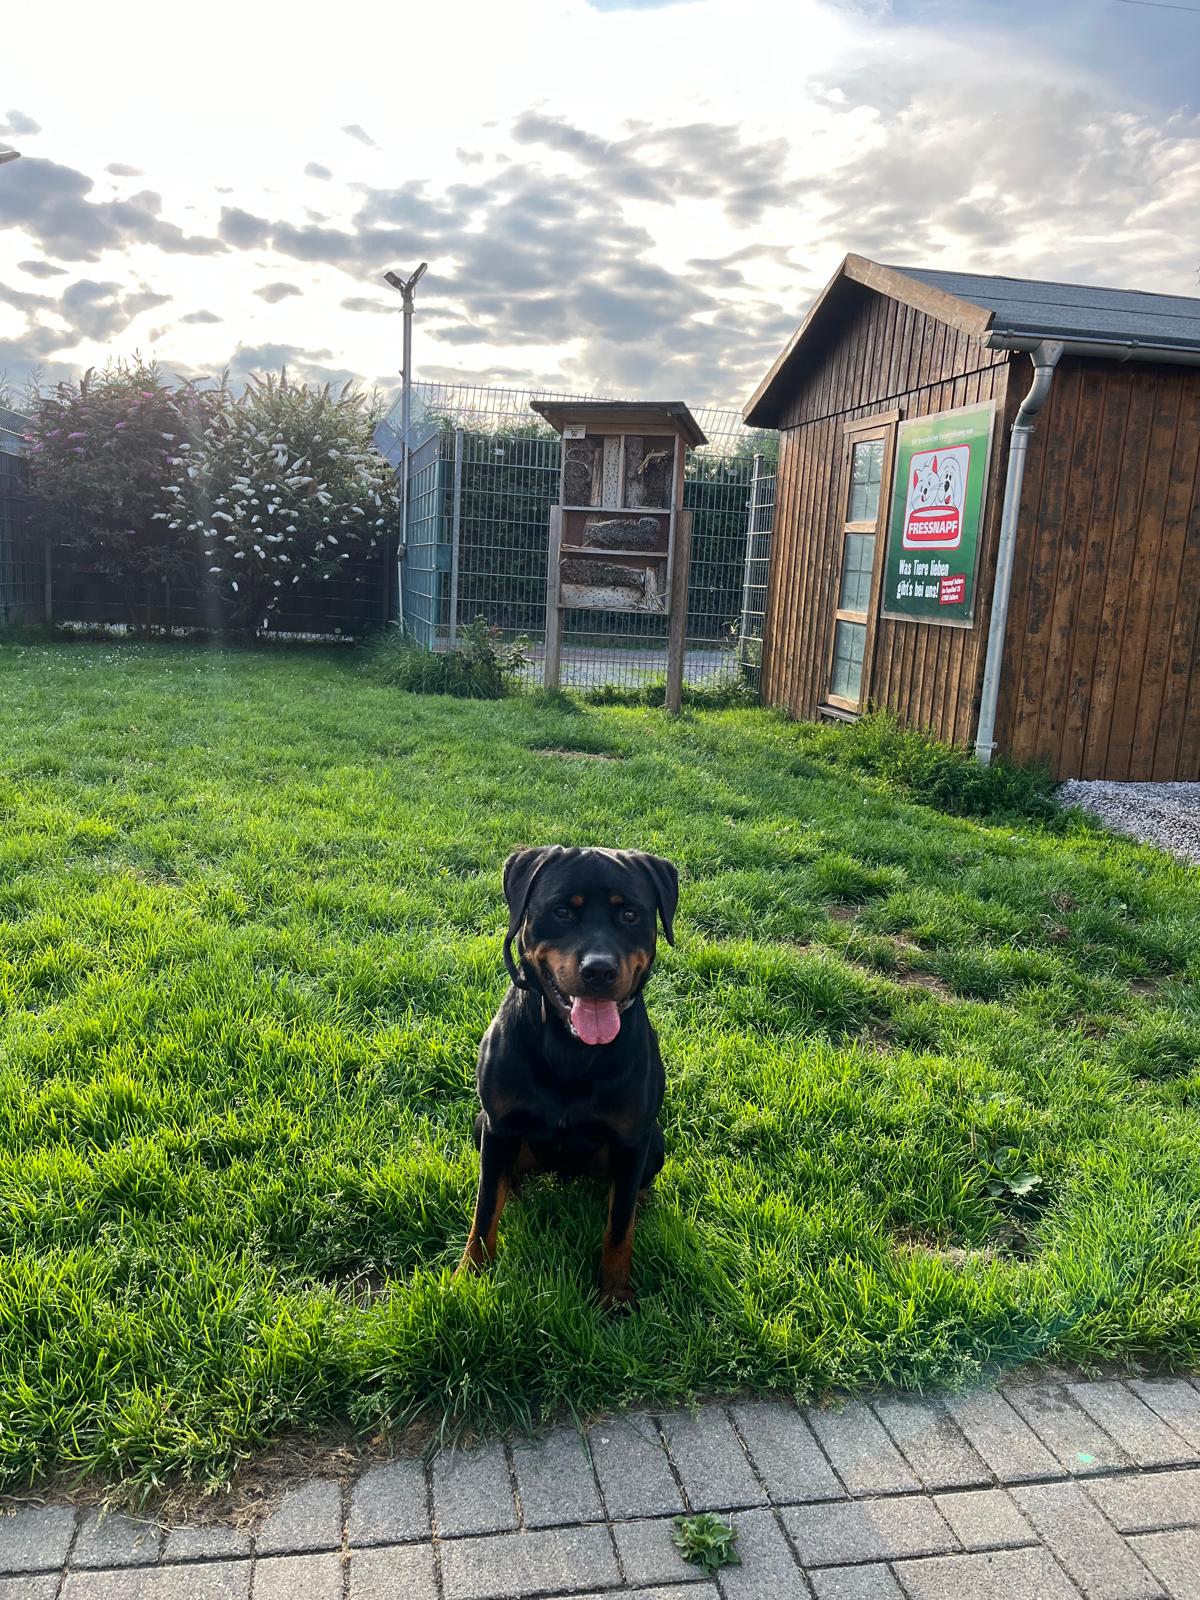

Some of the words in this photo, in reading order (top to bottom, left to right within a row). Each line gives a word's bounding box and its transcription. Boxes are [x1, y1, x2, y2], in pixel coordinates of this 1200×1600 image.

[908, 520, 958, 535] FRESSNAPF
[899, 559, 912, 576] Was
[913, 559, 929, 576] Tiere
[930, 559, 950, 577] lieben
[896, 578, 913, 600] gibt's
[914, 580, 925, 598] bei
[925, 581, 940, 599] uns!
